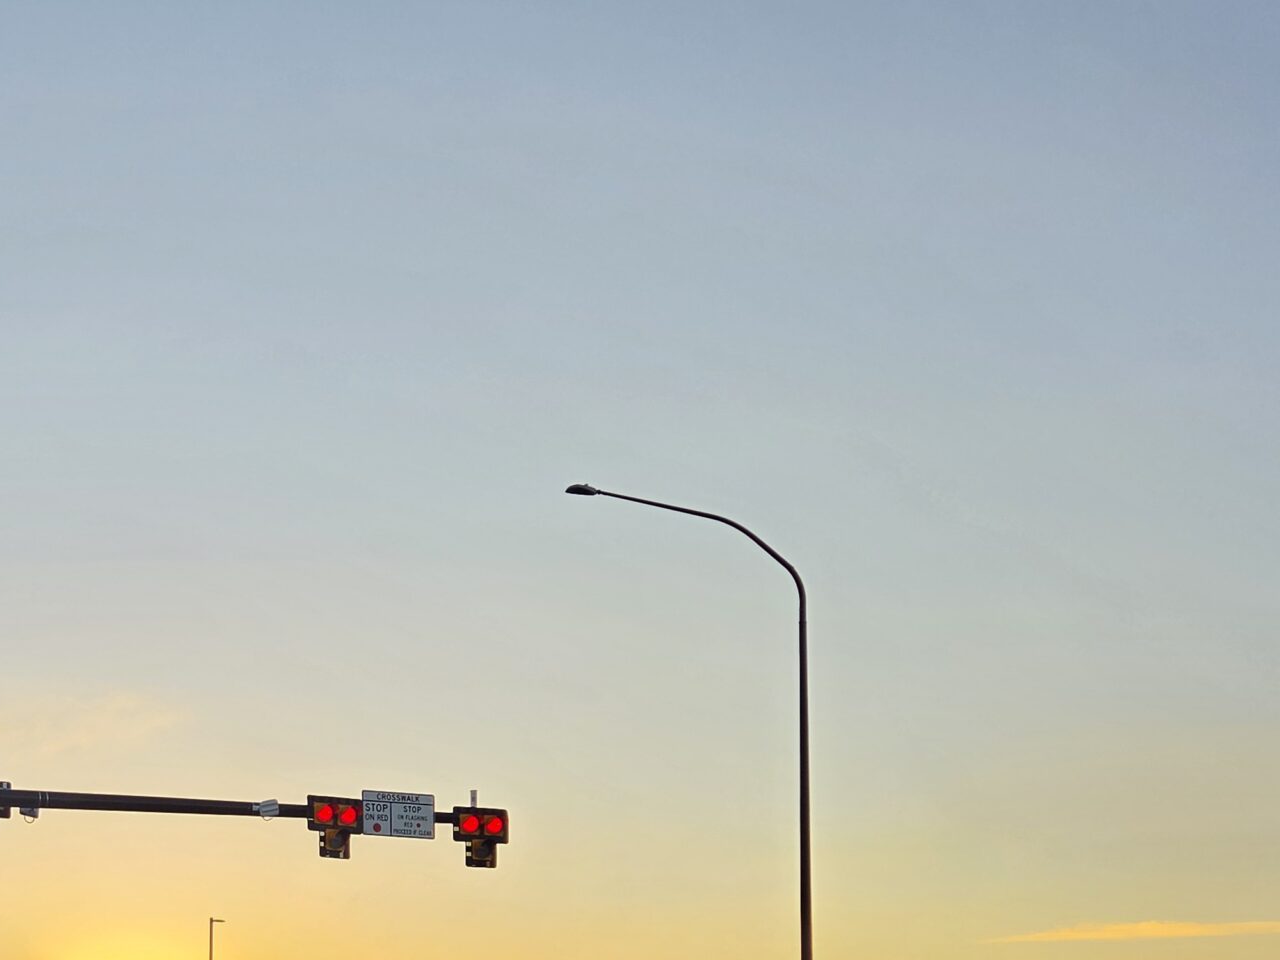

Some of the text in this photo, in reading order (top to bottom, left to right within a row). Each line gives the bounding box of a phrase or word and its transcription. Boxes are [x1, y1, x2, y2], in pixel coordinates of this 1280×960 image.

[376, 793, 420, 802] CROSSWALK
[365, 803, 388, 812] STOP
[377, 814, 388, 822] RED
